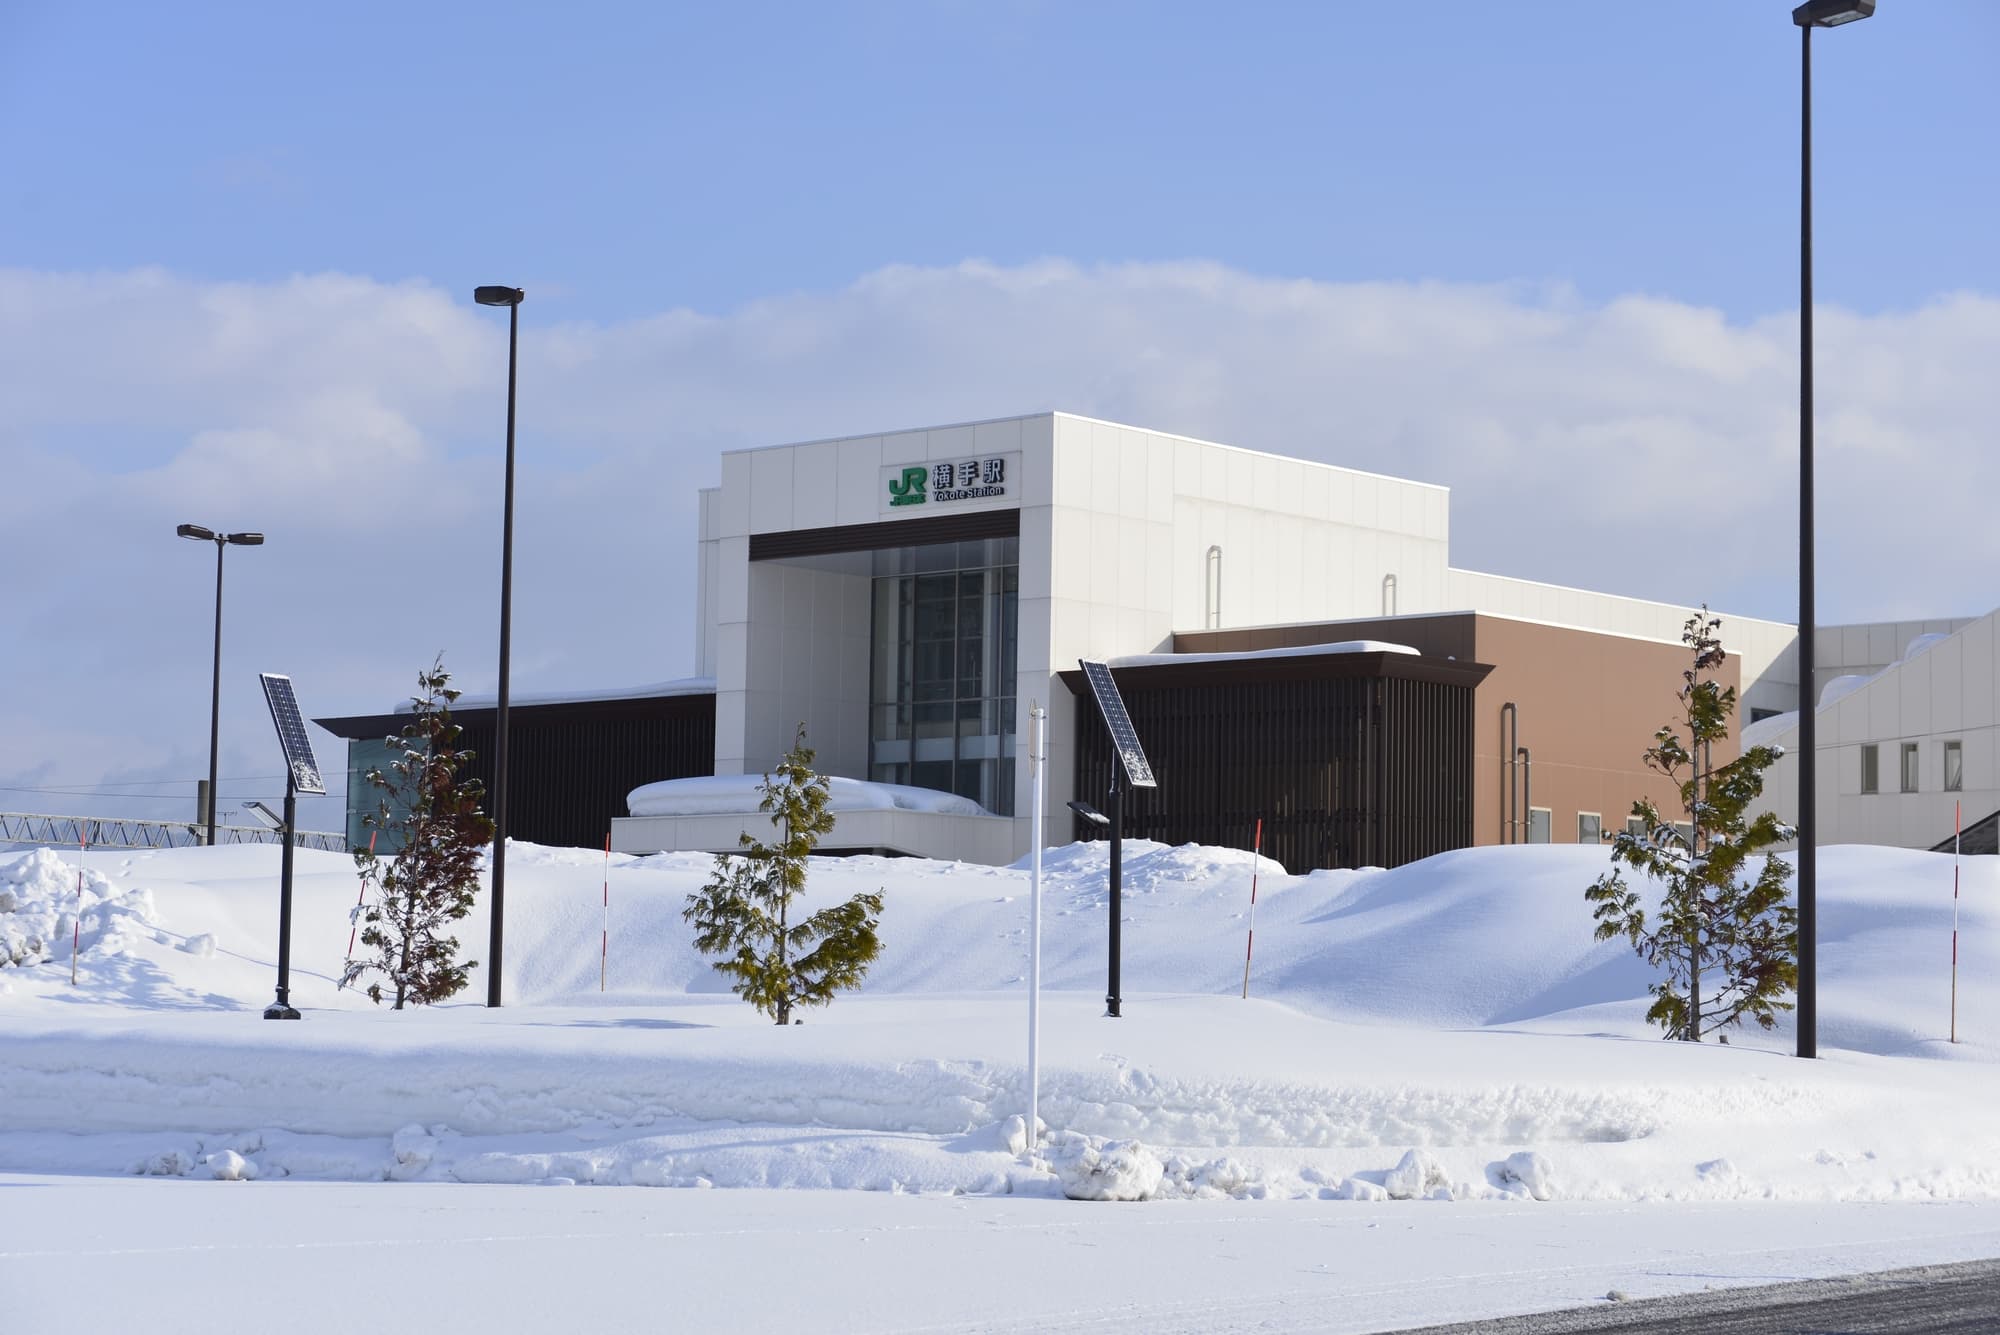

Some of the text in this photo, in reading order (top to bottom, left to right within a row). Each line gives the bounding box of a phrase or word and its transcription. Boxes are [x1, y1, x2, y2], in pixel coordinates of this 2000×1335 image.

[889, 467, 927, 495] JR
[932, 459, 1004, 489] 横手駅
[933, 489, 966, 501] Yokote
[967, 486, 1003, 498] Station
